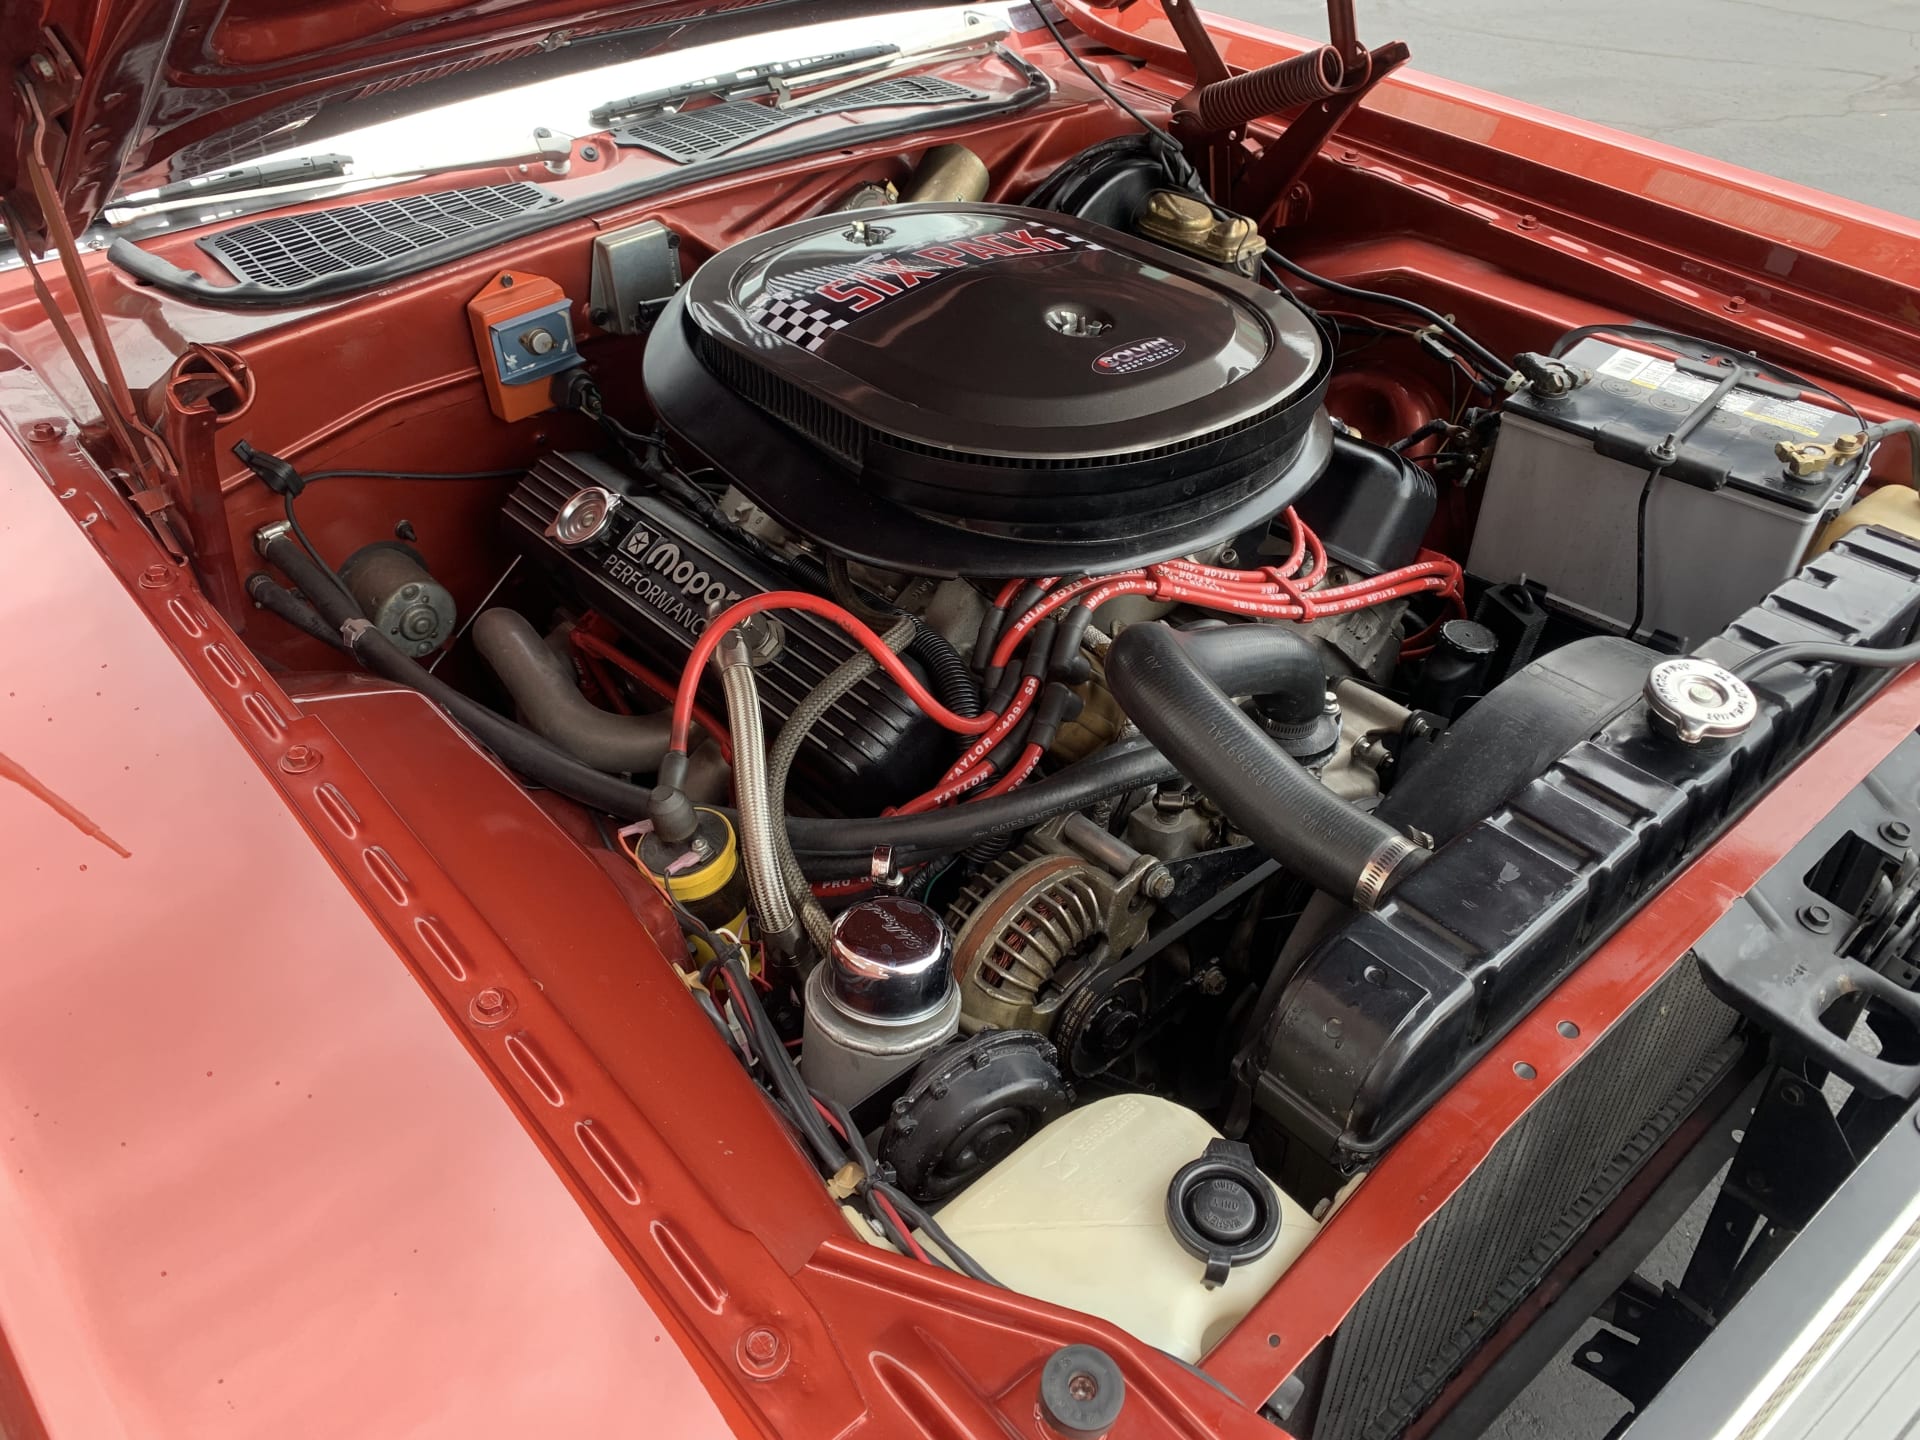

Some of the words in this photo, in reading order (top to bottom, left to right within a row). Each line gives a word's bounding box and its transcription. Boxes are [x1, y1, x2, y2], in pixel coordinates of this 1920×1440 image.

[816, 259, 937, 312] SIX
[913, 229, 1069, 268] PACK
[603, 554, 707, 637] PERFORMANC
[1086, 586, 1110, 609] SPIR
[1015, 603, 1046, 631] WIRE
[947, 737, 993, 781] TAYLOR
[934, 770, 989, 804] TAYLOR
[990, 817, 1026, 834] GATES
[1204, 1211, 1243, 1230] WASHER
